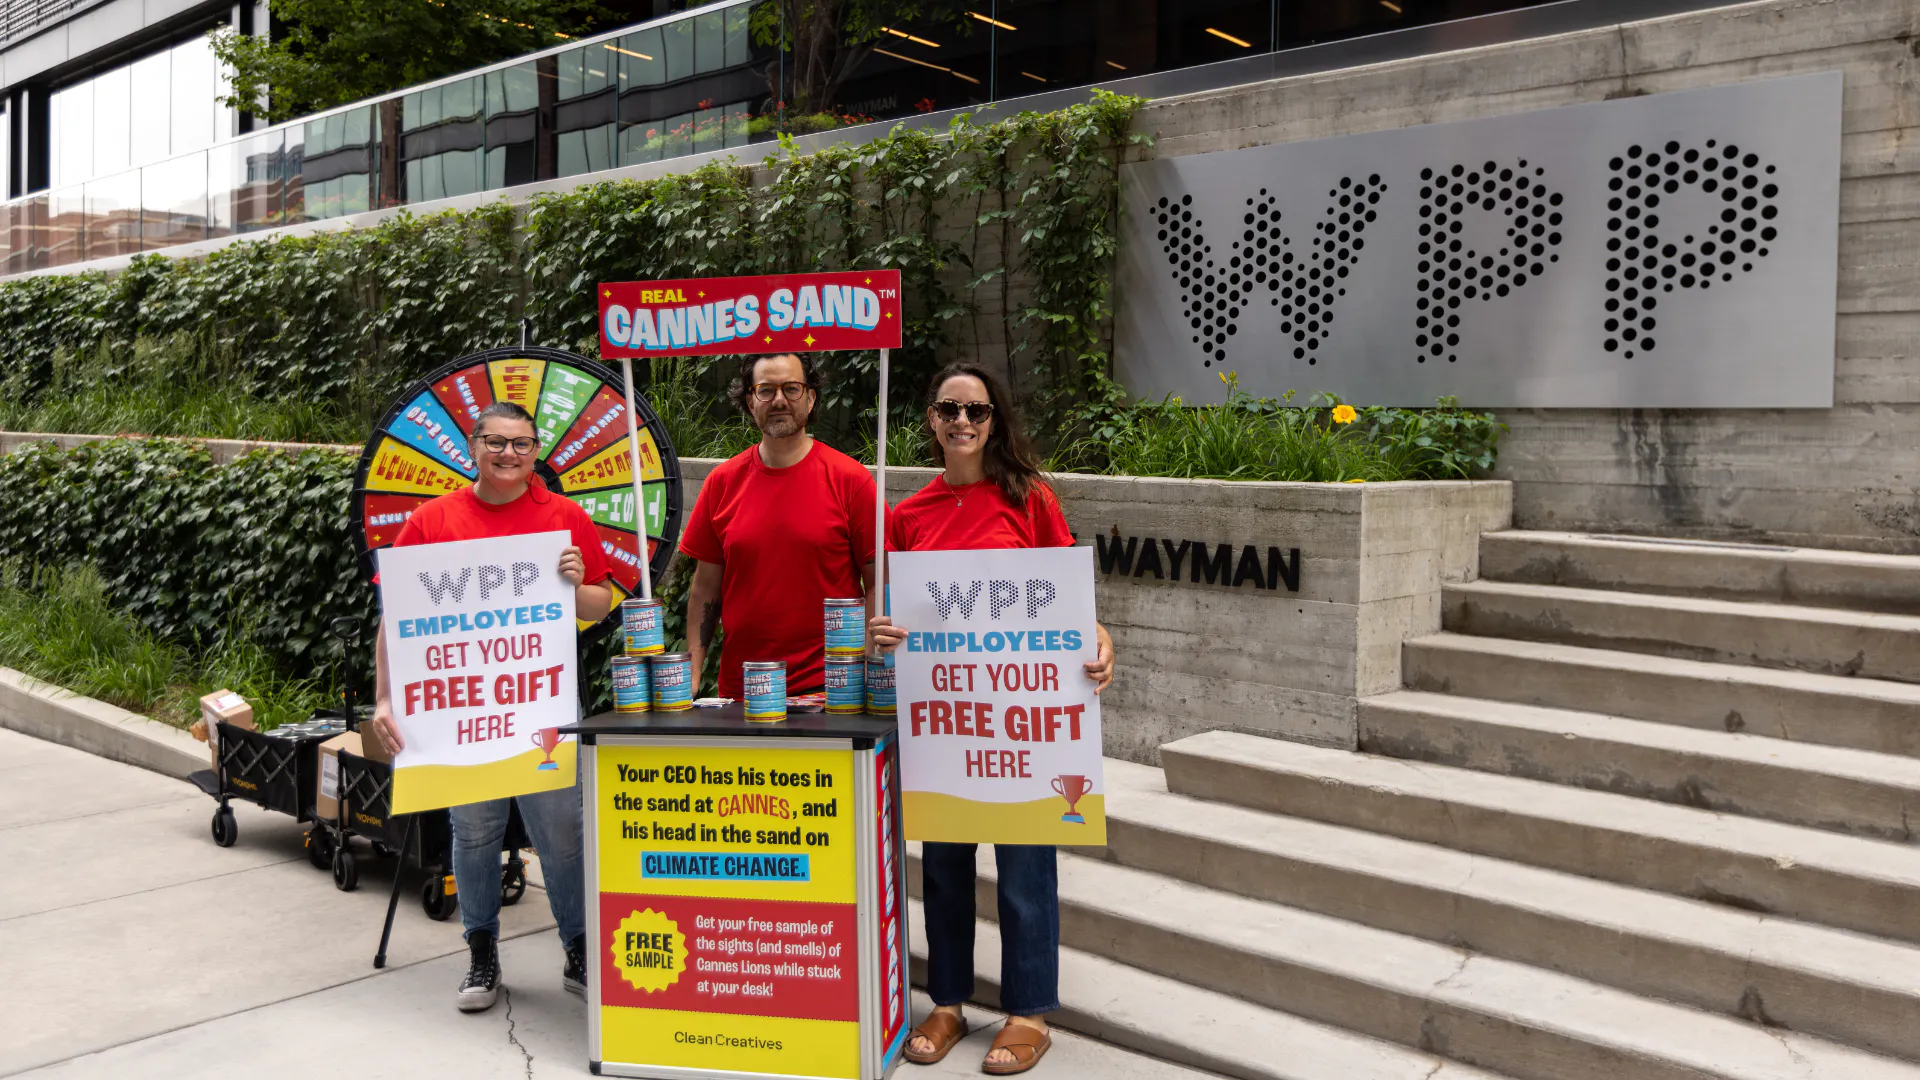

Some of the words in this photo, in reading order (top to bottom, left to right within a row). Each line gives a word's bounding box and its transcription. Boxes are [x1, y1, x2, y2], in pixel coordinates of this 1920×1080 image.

[1149, 138, 1780, 367] WPP
[641, 289, 687, 303] REAL
[605, 295, 761, 350] CANNES
[503, 366, 530, 400] FREE
[406, 406, 442, 439] SPIN
[596, 403, 625, 428] FREE
[569, 457, 615, 486] DRINK
[1095, 534, 1301, 592] WAYMAN
[417, 561, 540, 606] WPP
[925, 578, 1056, 621] WPP
[398, 602, 563, 638] EMPLOYEES
[425, 642, 469, 671] GET
[478, 633, 543, 665] YOUR
[906, 629, 1083, 653] EMPLOYEES
[404, 674, 486, 717] FREE
[494, 664, 565, 706] GIFT
[931, 663, 978, 692] GET
[986, 663, 1059, 692] YOUR
[457, 712, 516, 745] HERE
[910, 700, 995, 738] FREE
[1004, 703, 1086, 743] GIFT
[617, 763, 660, 783] Your
[664, 765, 697, 784] CEO
[701, 765, 734, 785] has
[738, 766, 766, 786] his
[769, 768, 811, 788] toes
[815, 768, 833, 788] in
[965, 749, 1032, 779] HERE
[613, 792, 643, 811] the
[647, 794, 691, 813] sand
[694, 797, 714, 813] at
[802, 798, 838, 818] and
[622, 821, 649, 840] his
[653, 822, 697, 842] head
[700, 824, 718, 842] in
[721, 824, 752, 844] the
[756, 826, 801, 846] sand
[805, 829, 830, 846] on
[645, 854, 720, 876] CLIMATE
[724, 856, 806, 878] CHANGE.
[696, 915, 716, 930] Get
[718, 918, 746, 933] your
[748, 916, 774, 932] free
[775, 919, 818, 938] sample
[820, 920, 834, 936] of
[625, 931, 674, 953] FREE
[696, 936, 717, 951] the
[718, 937, 754, 956] sights
[756, 939, 783, 955] (and
[784, 940, 826, 958] smells)
[828, 942, 842, 957] of
[626, 951, 674, 970] SAMPLE
[697, 957, 738, 973] Cannes
[741, 959, 771, 975] Lions
[773, 961, 805, 977] while
[807, 963, 841, 979] stuck
[697, 981, 710, 993] at
[712, 983, 740, 997] your
[741, 981, 774, 996] desk!
[674, 1031, 713, 1046] Clean
[715, 1033, 783, 1051] Creatives
